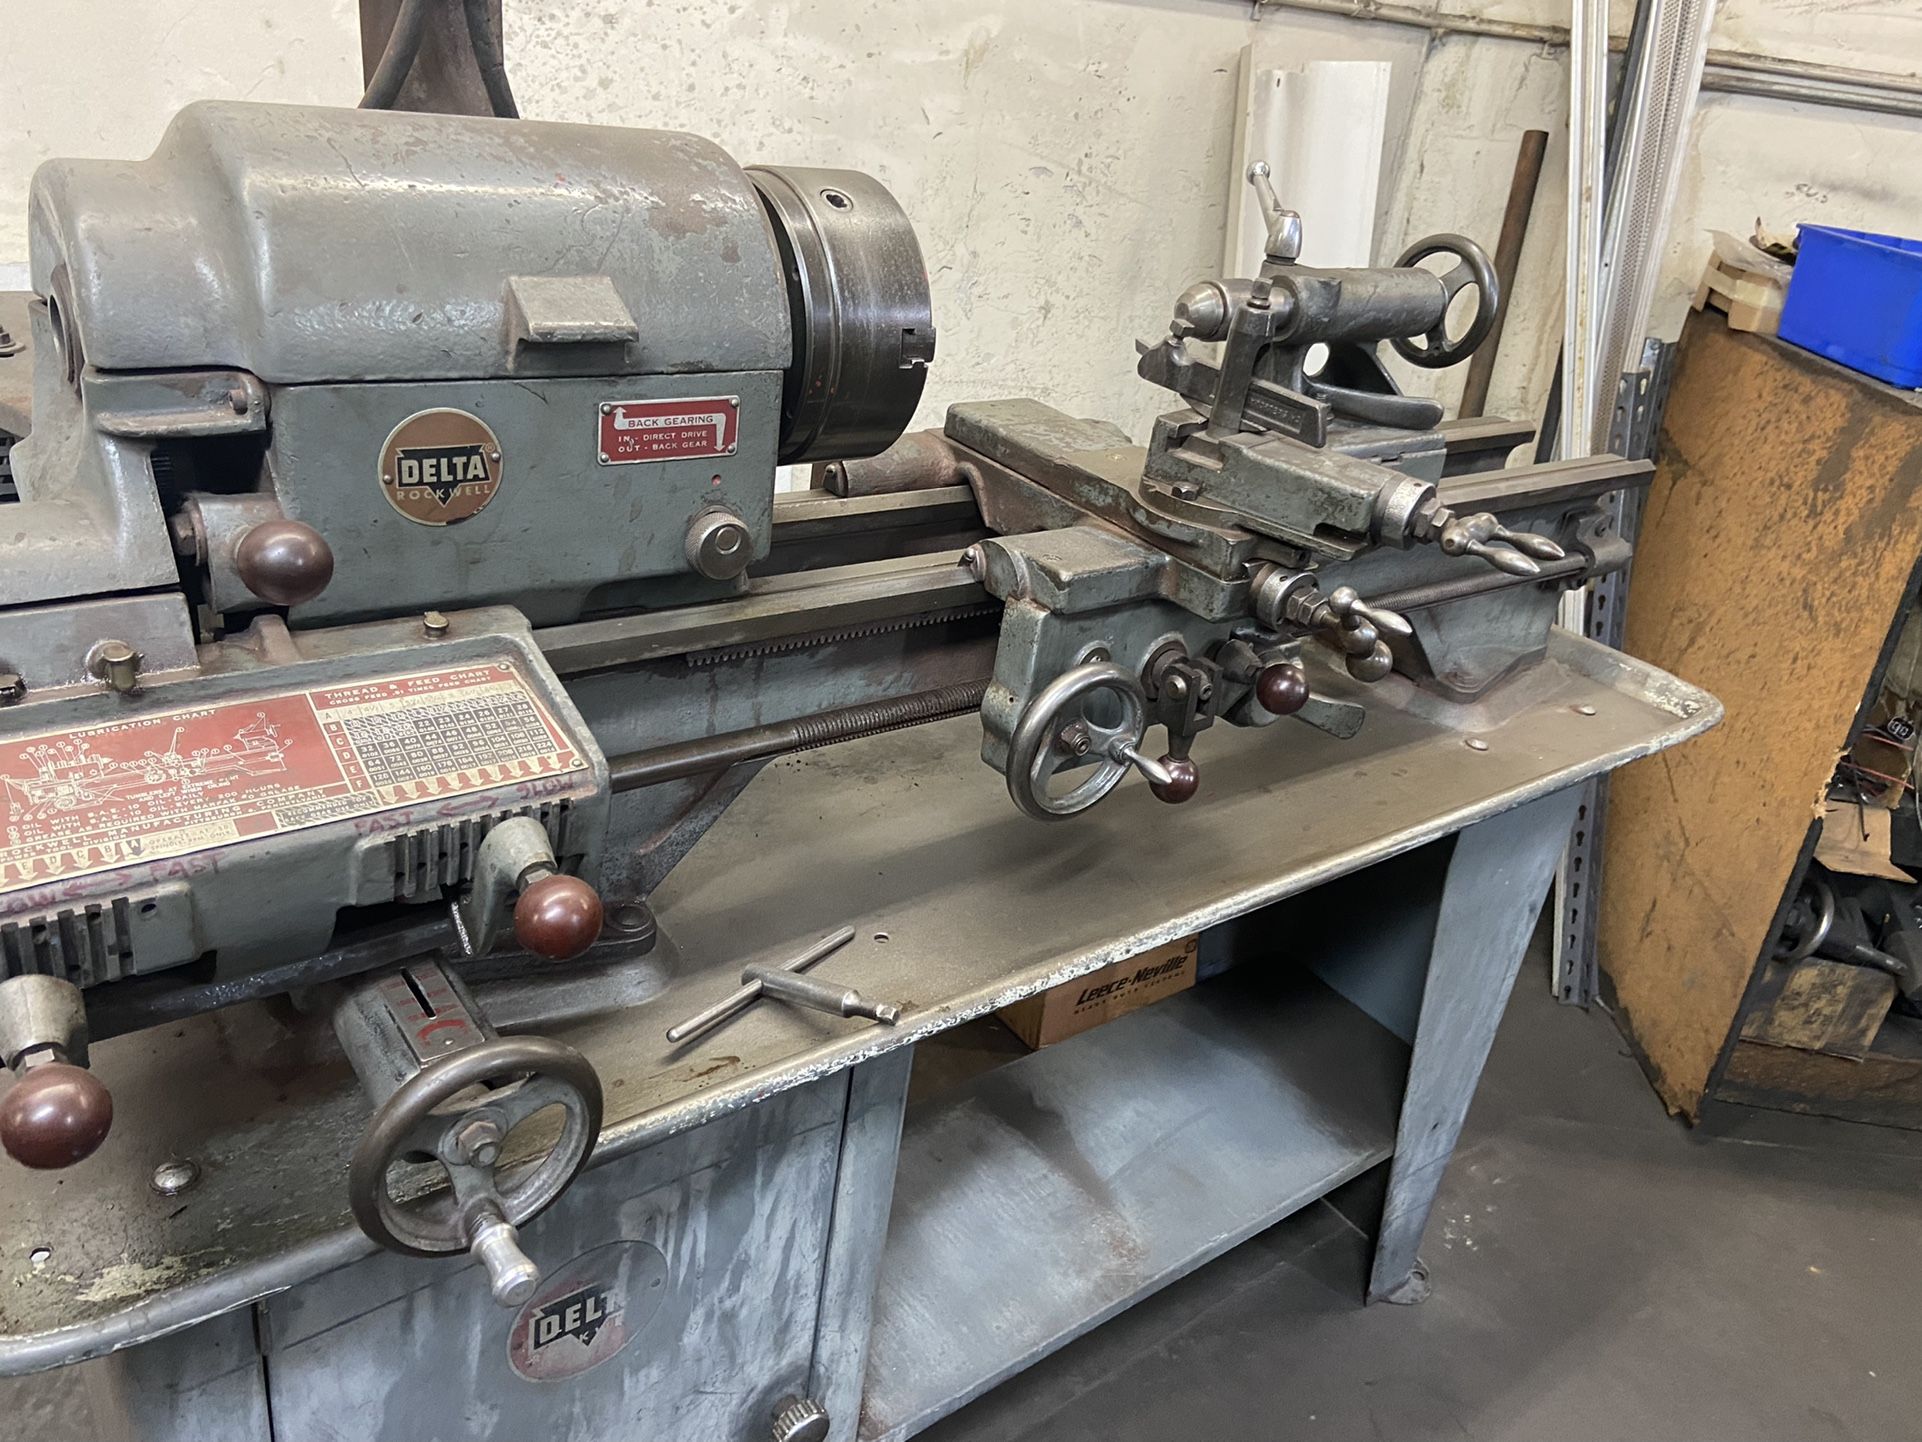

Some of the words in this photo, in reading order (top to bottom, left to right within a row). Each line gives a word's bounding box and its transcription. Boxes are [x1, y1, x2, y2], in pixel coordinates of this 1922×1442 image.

[628, 418, 659, 428] BACK
[664, 415, 714, 426] GEARING
[643, 432, 677, 441] DIRECT
[681, 430, 708, 439] DRIVE
[618, 445, 640, 453] OUT
[652, 443, 678, 451] BACK
[682, 440, 708, 448] GEAR
[401, 455, 486, 484] DELTA
[397, 485, 491, 501] ROCKWELL
[324, 686, 378, 699] THREAD
[408, 677, 440, 687] FEED
[450, 670, 490, 681] CHART
[70, 719, 161, 739] LUBRICATION
[173, 710, 216, 721] CHART
[336, 738, 344, 746] C
[343, 751, 351, 759] D
[350, 766, 358, 774] E
[357, 781, 363, 789] F
[108, 806, 241, 836] MANUFACTURING
[257, 789, 324, 807] COMPANY
[26, 830, 72, 843] GREASE
[99, 814, 155, 828] REQUIRED
[160, 808, 188, 817] WITH
[50, 816, 79, 824] WITH
[52, 822, 81, 831] WITH
[354, 810, 414, 835] FAST
[105, 845, 112, 853] B
[131, 840, 139, 848] A
[150, 851, 225, 881] FAST
[539, 1290, 625, 1344] DELT
